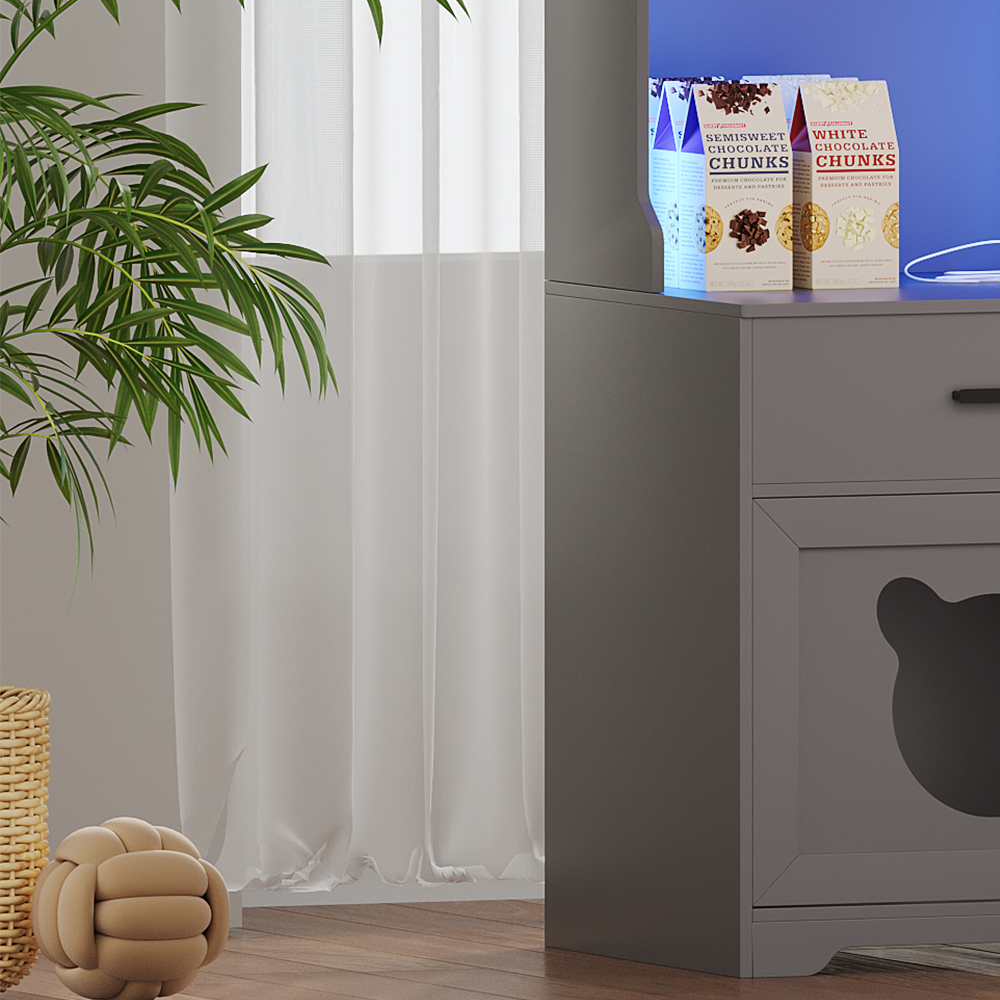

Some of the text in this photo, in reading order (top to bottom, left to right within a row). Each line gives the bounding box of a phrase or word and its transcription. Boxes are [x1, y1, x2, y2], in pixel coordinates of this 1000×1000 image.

[706, 133, 786, 142] SEMISWEET
[812, 129, 868, 140] WHITE
[708, 144, 789, 153] CHOCOLATE
[815, 142, 895, 151] CHOCOLATE
[710, 156, 789, 170] CHUNKS
[816, 154, 896, 168] CHUNKS
